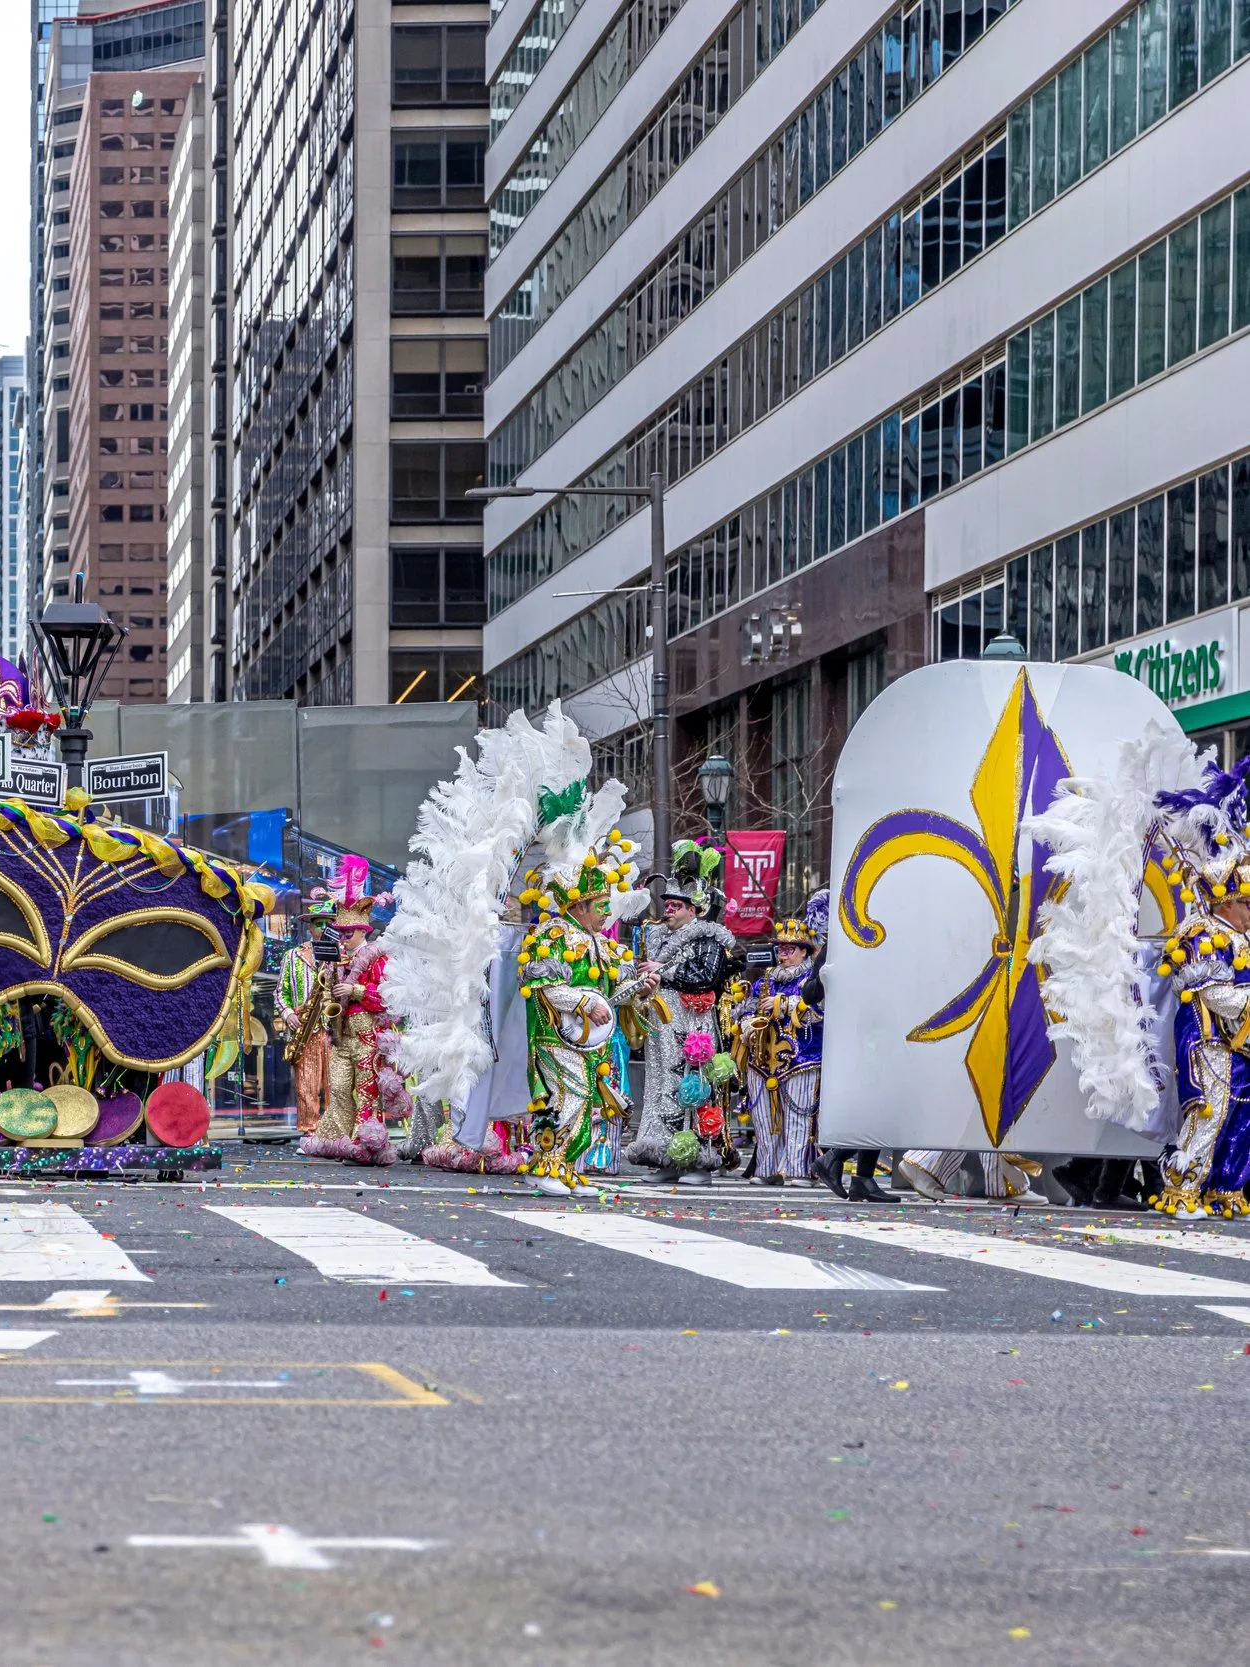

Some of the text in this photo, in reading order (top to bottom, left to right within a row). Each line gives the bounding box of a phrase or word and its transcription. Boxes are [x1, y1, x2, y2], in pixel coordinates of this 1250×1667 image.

[1135, 640, 1220, 701] Citizens
[16, 774, 56, 795] Quarter
[93, 770, 160, 791] Bourbon
